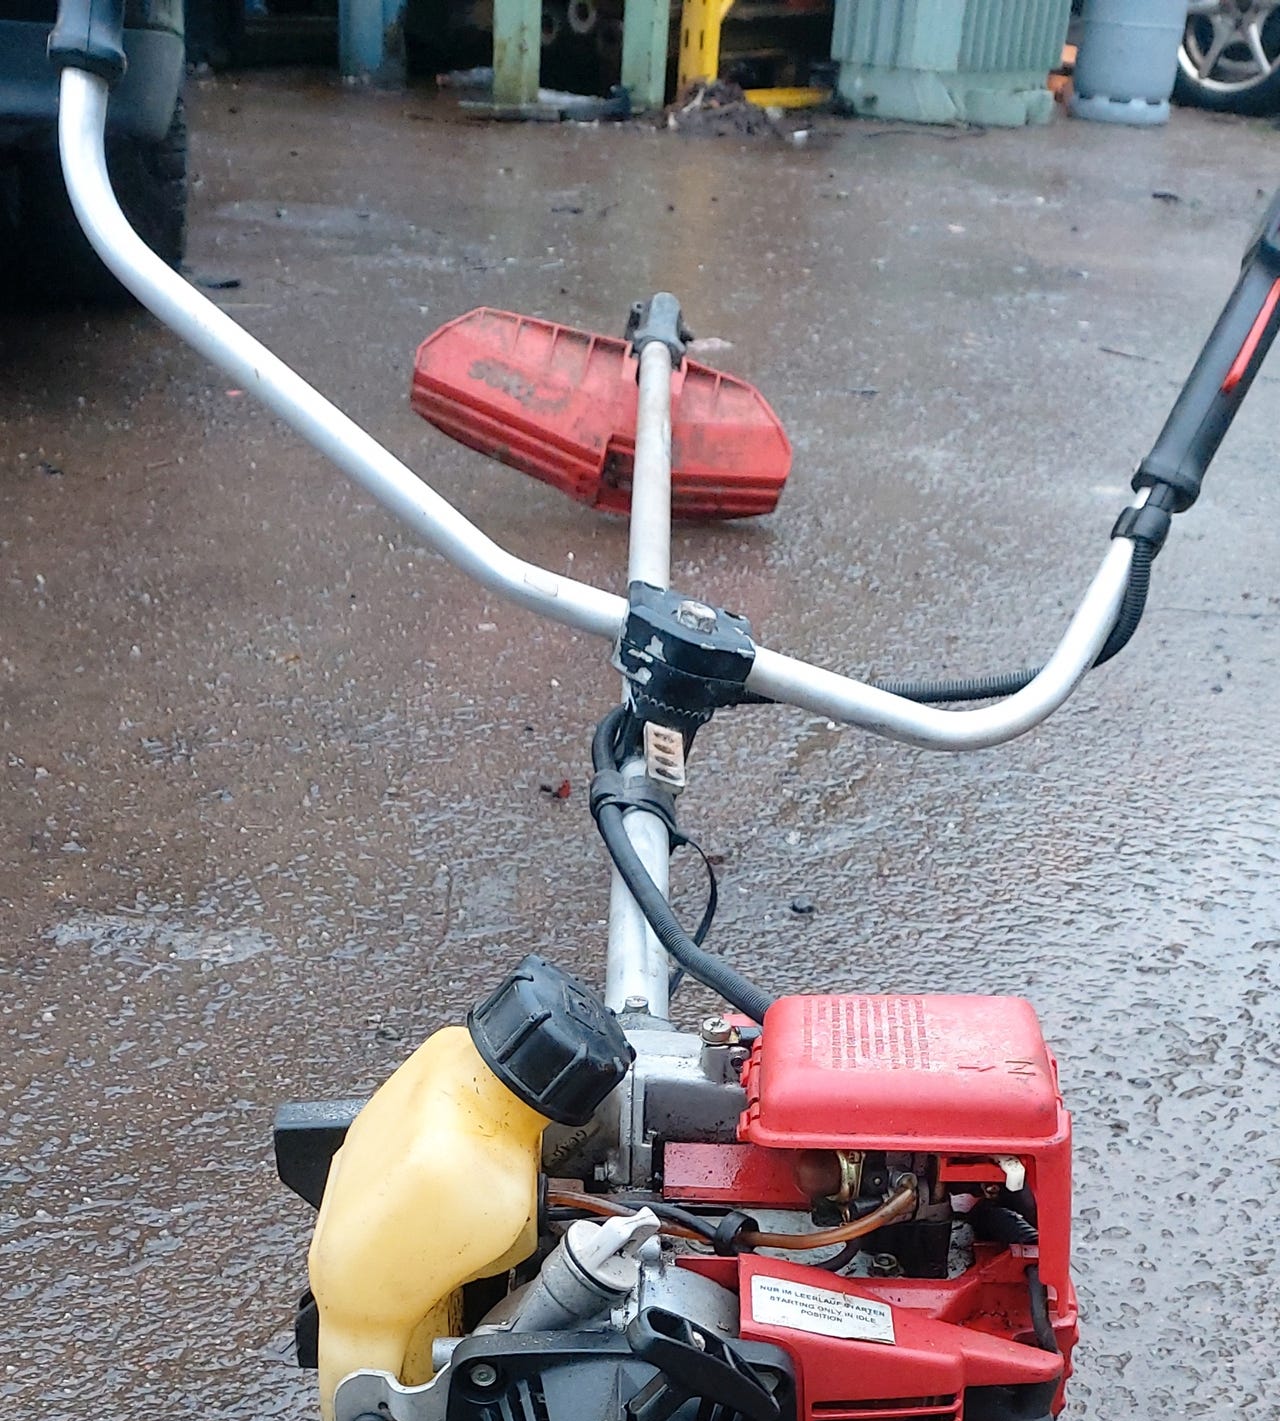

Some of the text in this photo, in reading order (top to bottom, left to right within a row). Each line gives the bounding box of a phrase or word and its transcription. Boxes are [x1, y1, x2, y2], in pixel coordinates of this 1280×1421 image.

[760, 1285, 779, 1293] NUR
[794, 1292, 842, 1306] LEERLAUF
[770, 1295, 815, 1309] STARTING
[817, 1306, 842, 1316] ONLY
[856, 1314, 876, 1323] IDLE
[801, 1309, 843, 1323] POSITION
